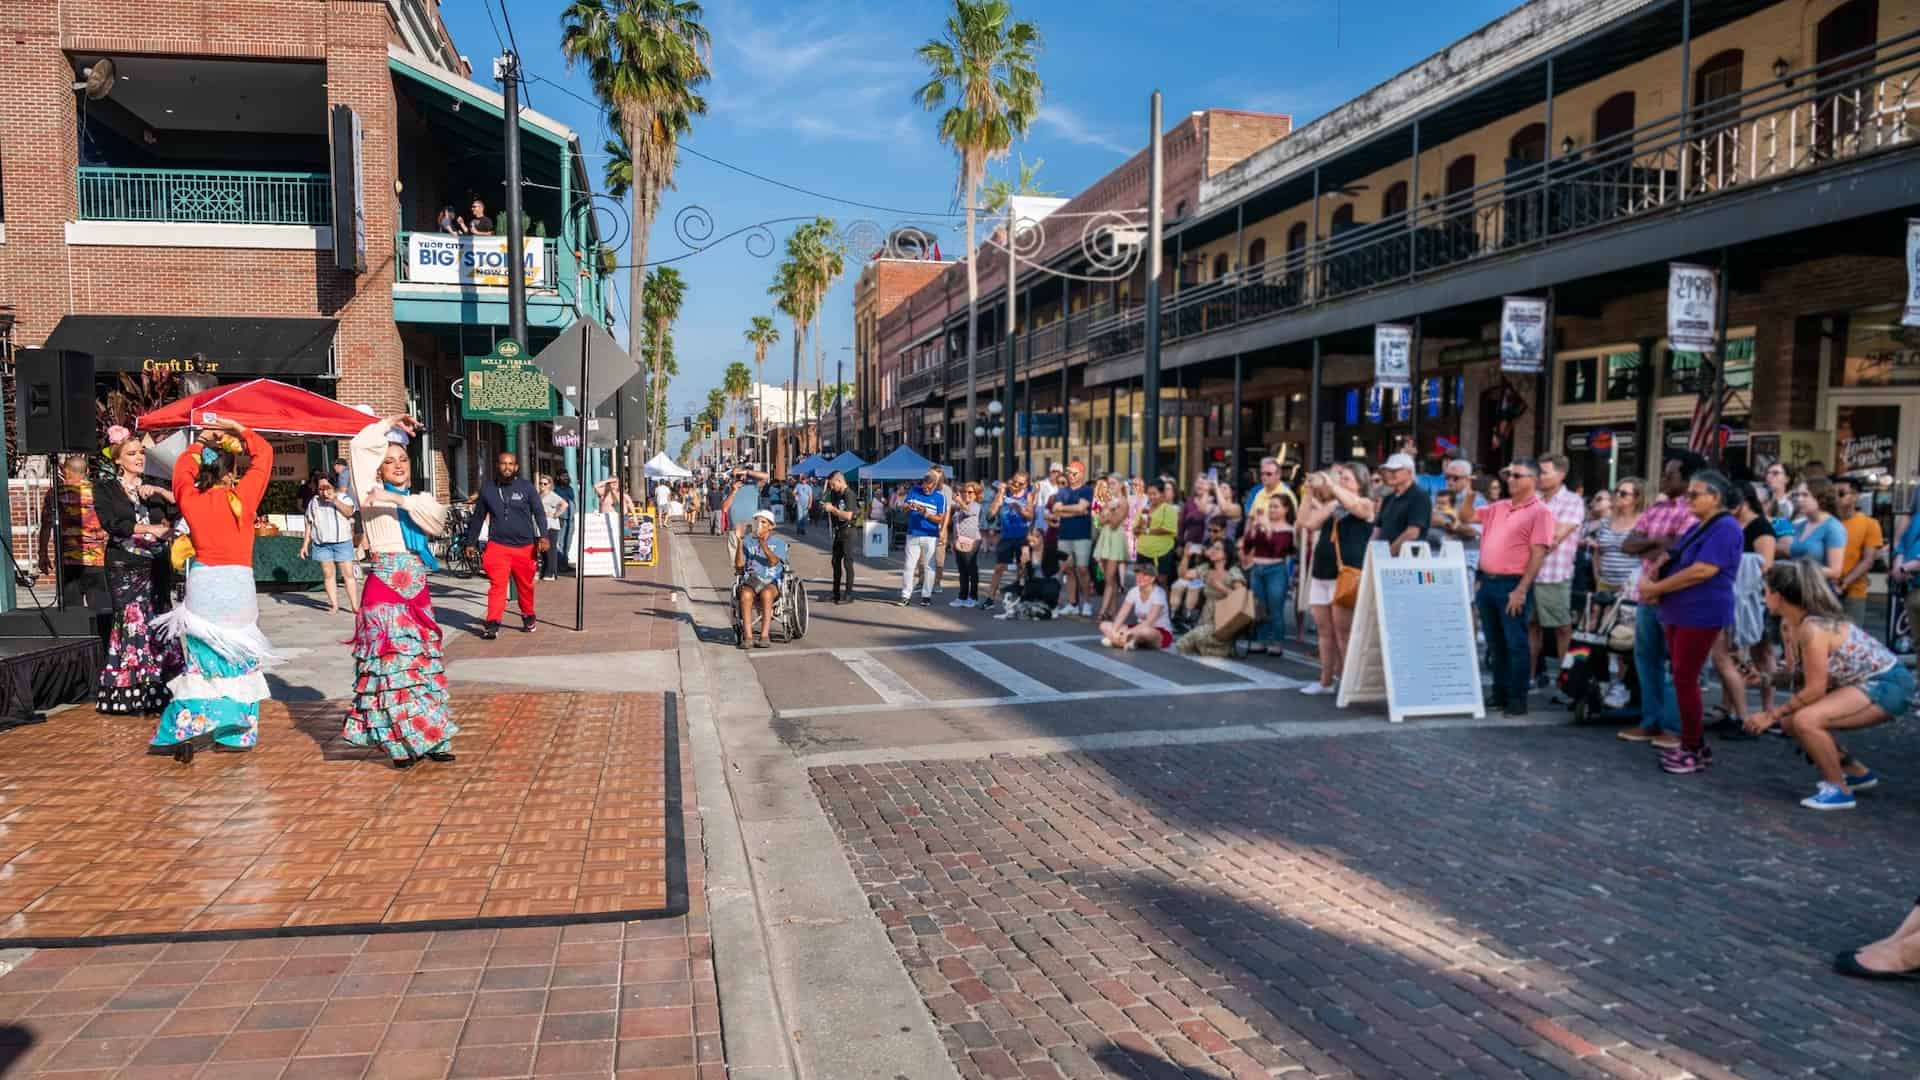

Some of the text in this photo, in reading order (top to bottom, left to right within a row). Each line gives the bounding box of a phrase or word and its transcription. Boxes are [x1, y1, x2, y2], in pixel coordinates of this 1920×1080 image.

[419, 249, 455, 266] BIG
[1677, 288, 1712, 300] CITY
[143, 359, 219, 371] Craft Ber
